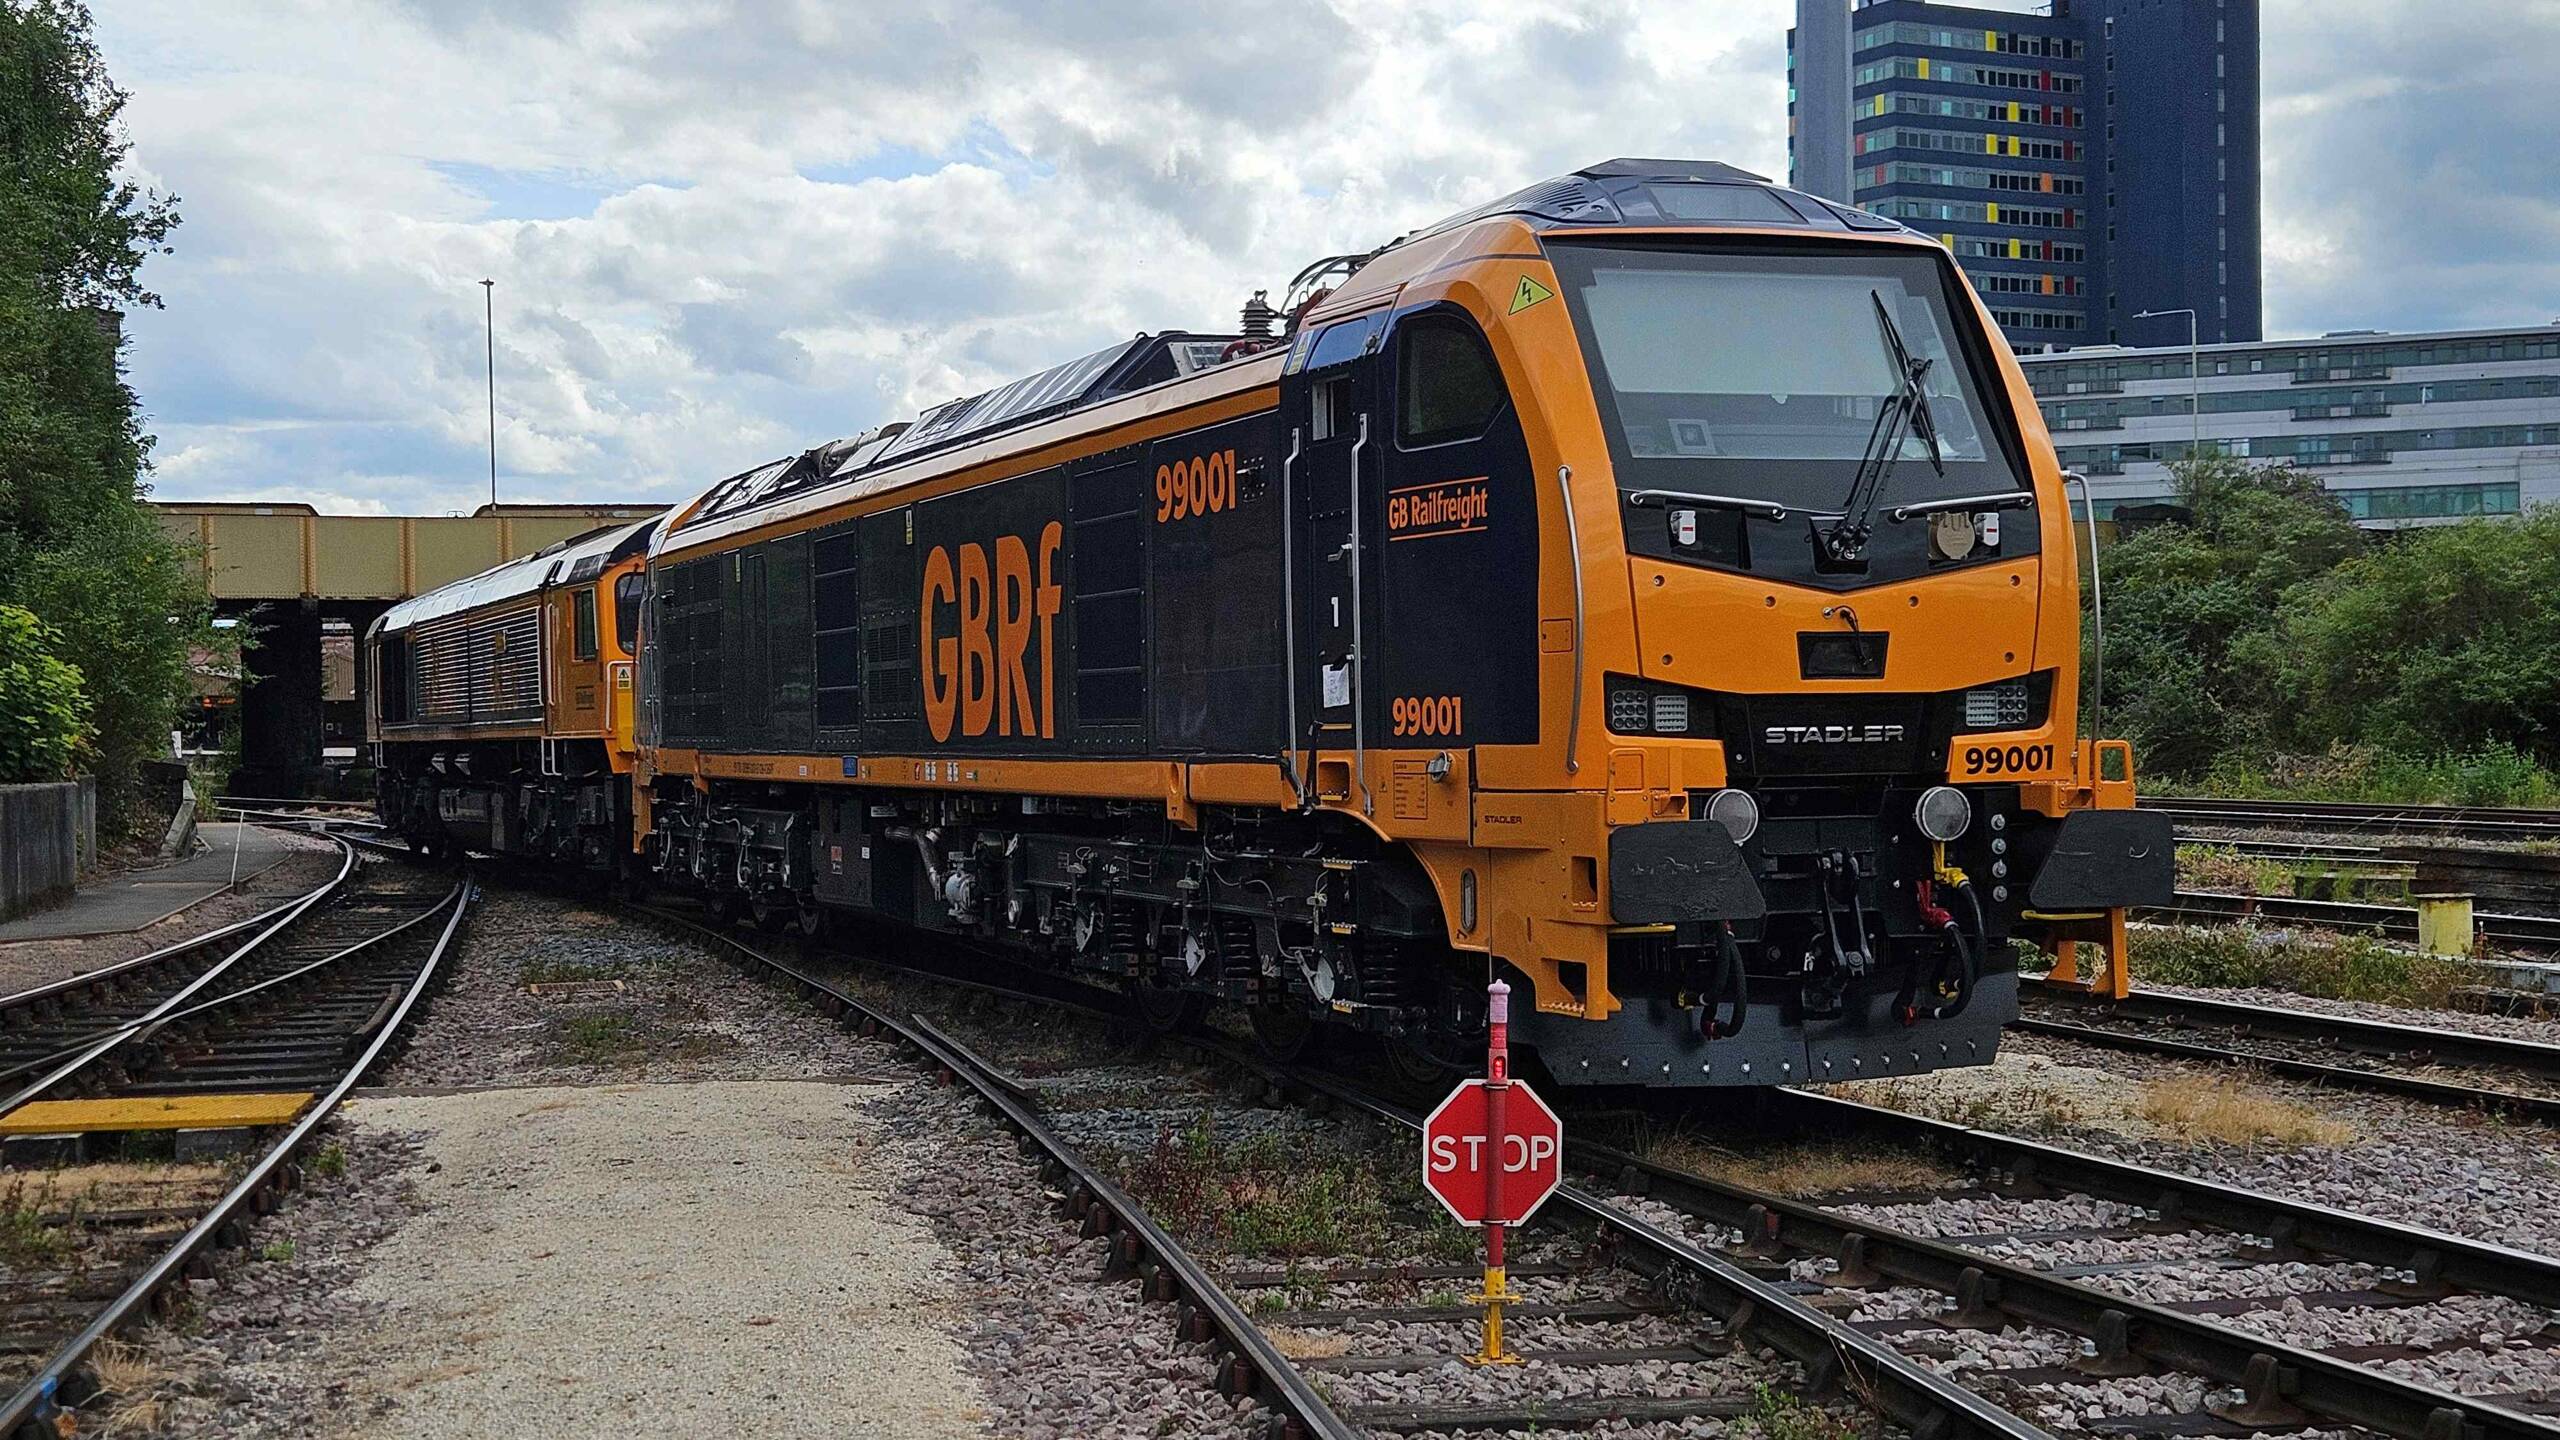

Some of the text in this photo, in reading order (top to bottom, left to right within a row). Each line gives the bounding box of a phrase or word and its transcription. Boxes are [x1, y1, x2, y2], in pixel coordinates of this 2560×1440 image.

[1156, 449, 1236, 523] 99001
[1389, 485, 1488, 529] GB Railfreight
[1331, 597, 1339, 627] 1
[921, 521, 1063, 742] GBRf
[1393, 696, 1461, 736] 99001
[1765, 725, 1903, 744] STADLER
[1965, 744, 2054, 775] 99001
[1484, 815, 1522, 824] STADLER
[1431, 1135, 1555, 1172] STOP
